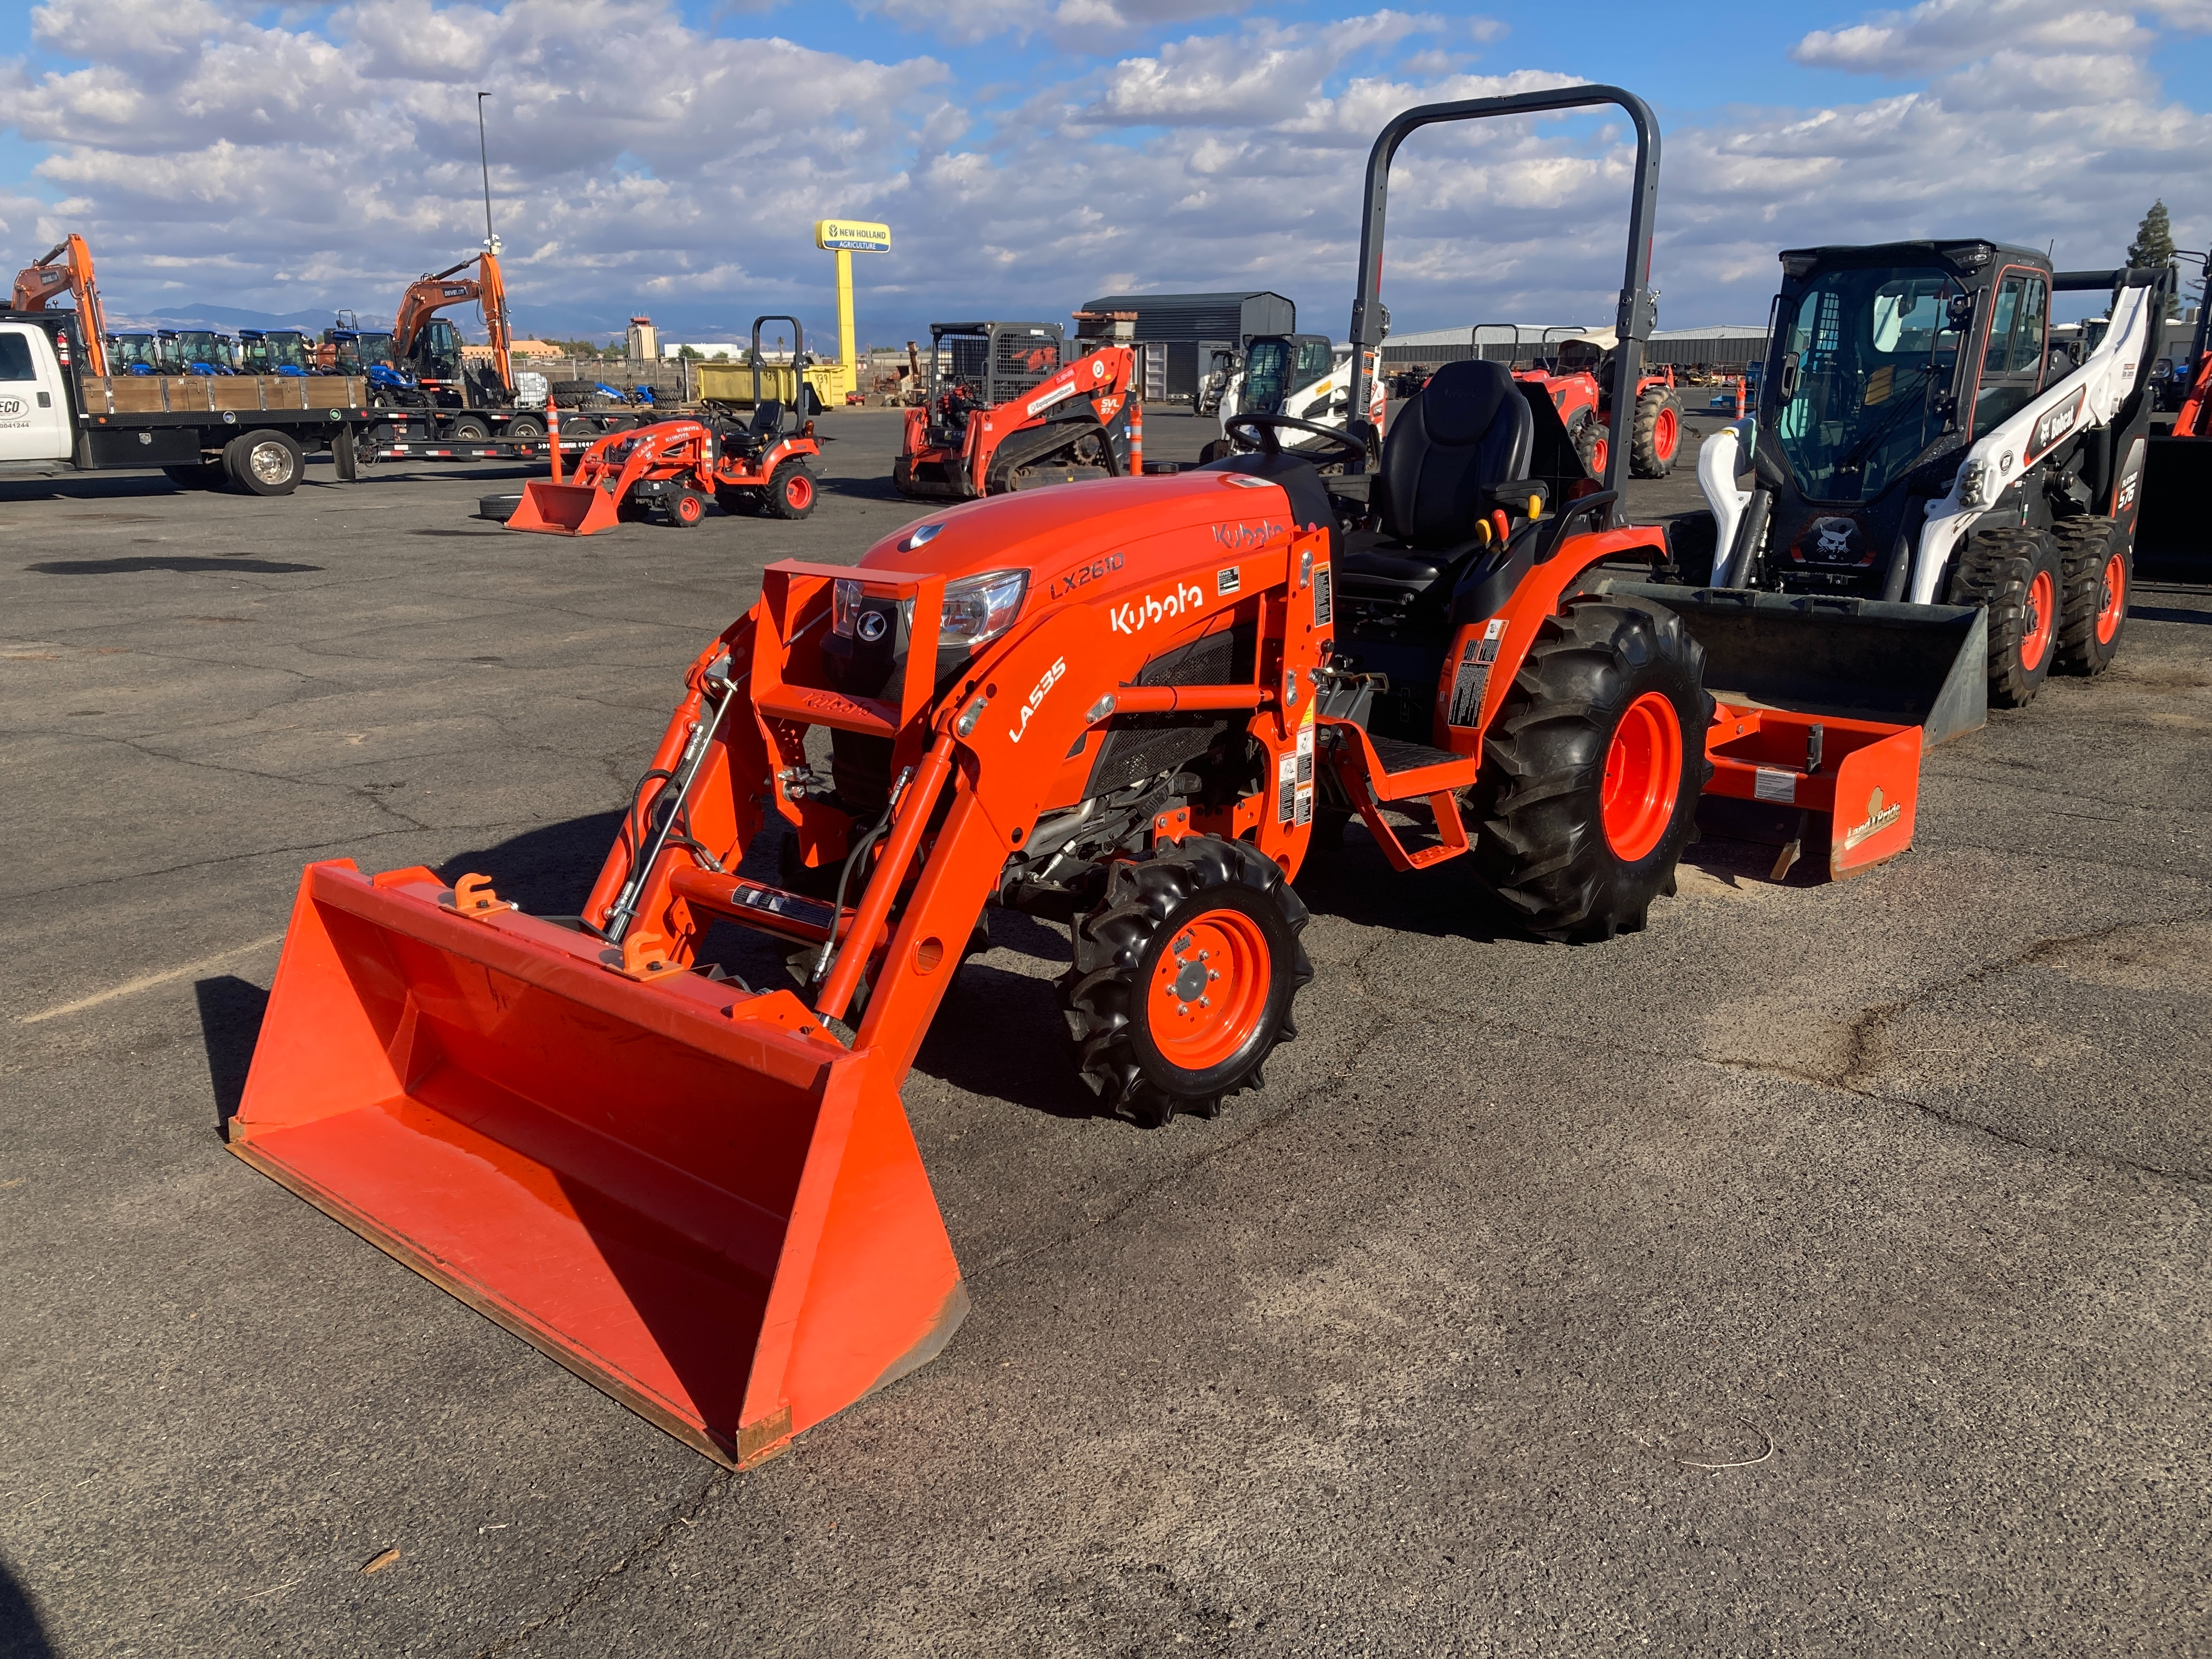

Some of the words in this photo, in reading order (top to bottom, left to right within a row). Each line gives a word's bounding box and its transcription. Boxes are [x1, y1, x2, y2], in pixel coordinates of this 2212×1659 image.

[839, 228, 855, 237] NEW
[856, 229, 886, 239] HOLLAND
[839, 241, 876, 250] AGRICULTURE
[763, 370, 776, 382] 439
[815, 374, 828, 383] 439
[1036, 386, 1072, 409] EquipmentShare
[1101, 399, 1120, 407] SVL
[2051, 406, 2074, 439] Bobcat
[665, 432, 690, 442] KUBOTA
[1212, 519, 1284, 549] Kubota
[1049, 552, 1125, 600] LX2610
[1110, 582, 1203, 634] Kubota
[1009, 656, 1066, 743] LA535
[1847, 816, 1871, 838] Land
[1877, 802, 1900, 821] Pride
